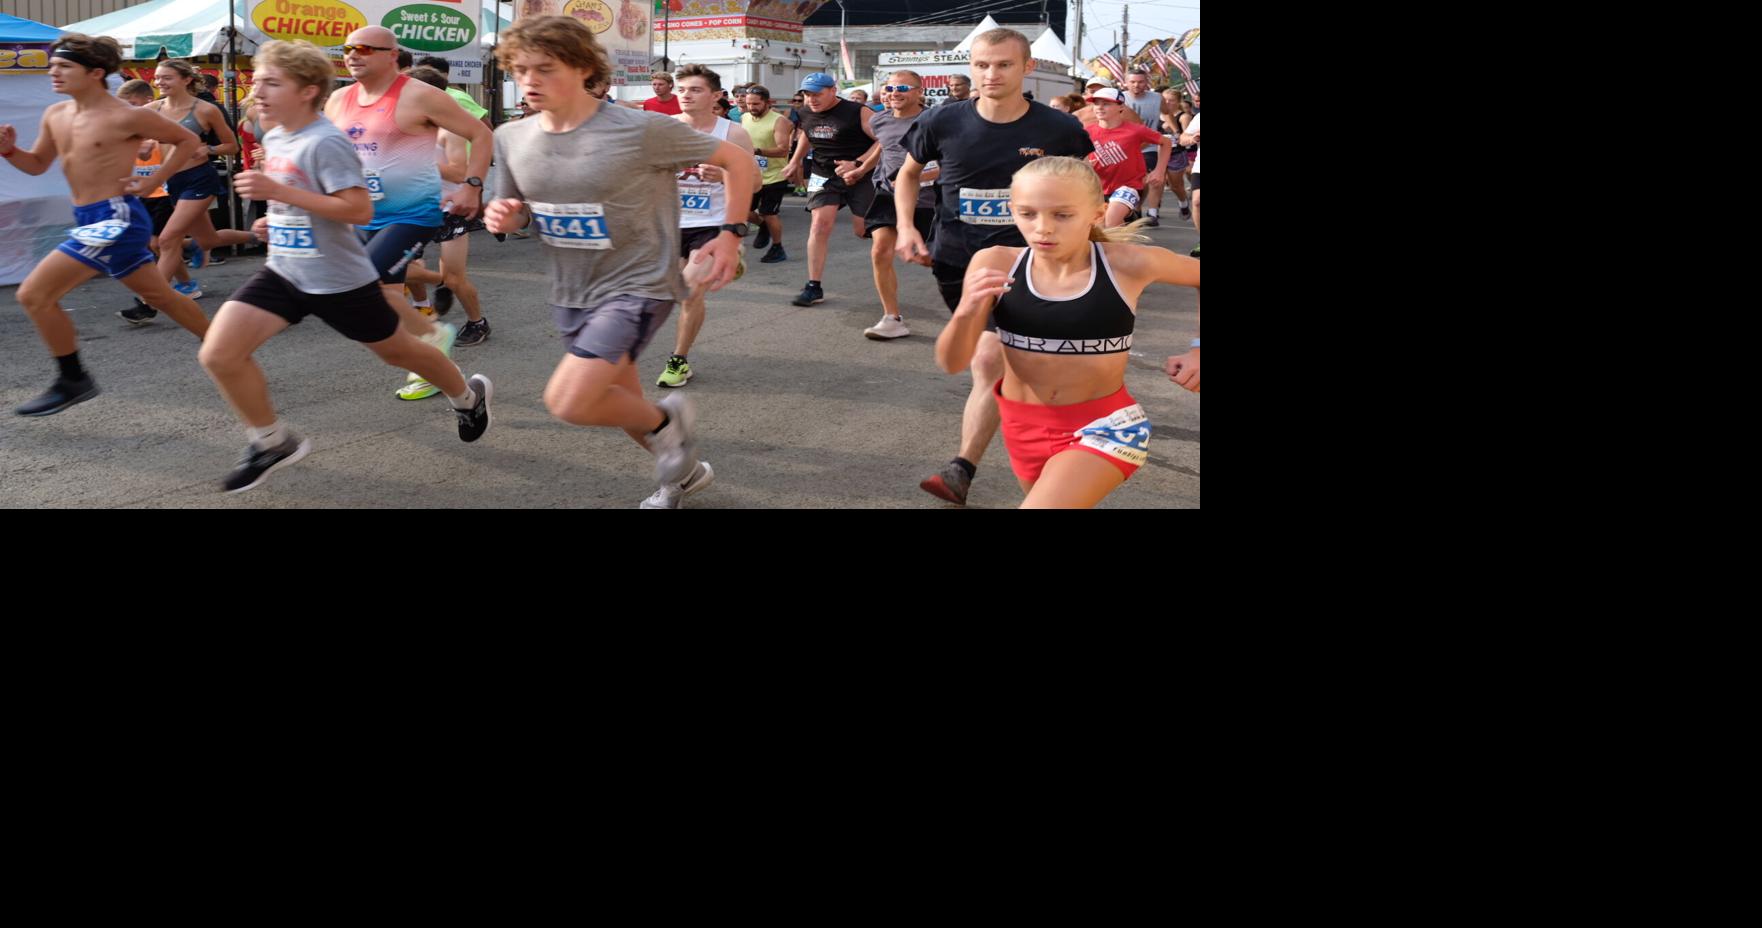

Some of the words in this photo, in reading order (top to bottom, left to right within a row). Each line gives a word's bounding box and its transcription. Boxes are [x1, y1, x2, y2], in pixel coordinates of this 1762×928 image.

[275, 0, 347, 20] Orange
[400, 9, 428, 22] Sweet
[431, 12, 438, 24] &
[441, 13, 461, 25] Sour
[262, 16, 360, 37] CHICKEN
[391, 23, 470, 42] CHICKEN
[465, 60, 482, 68] CHICKEN
[933, 54, 971, 62] STEAK
[535, 216, 606, 237] 1641
